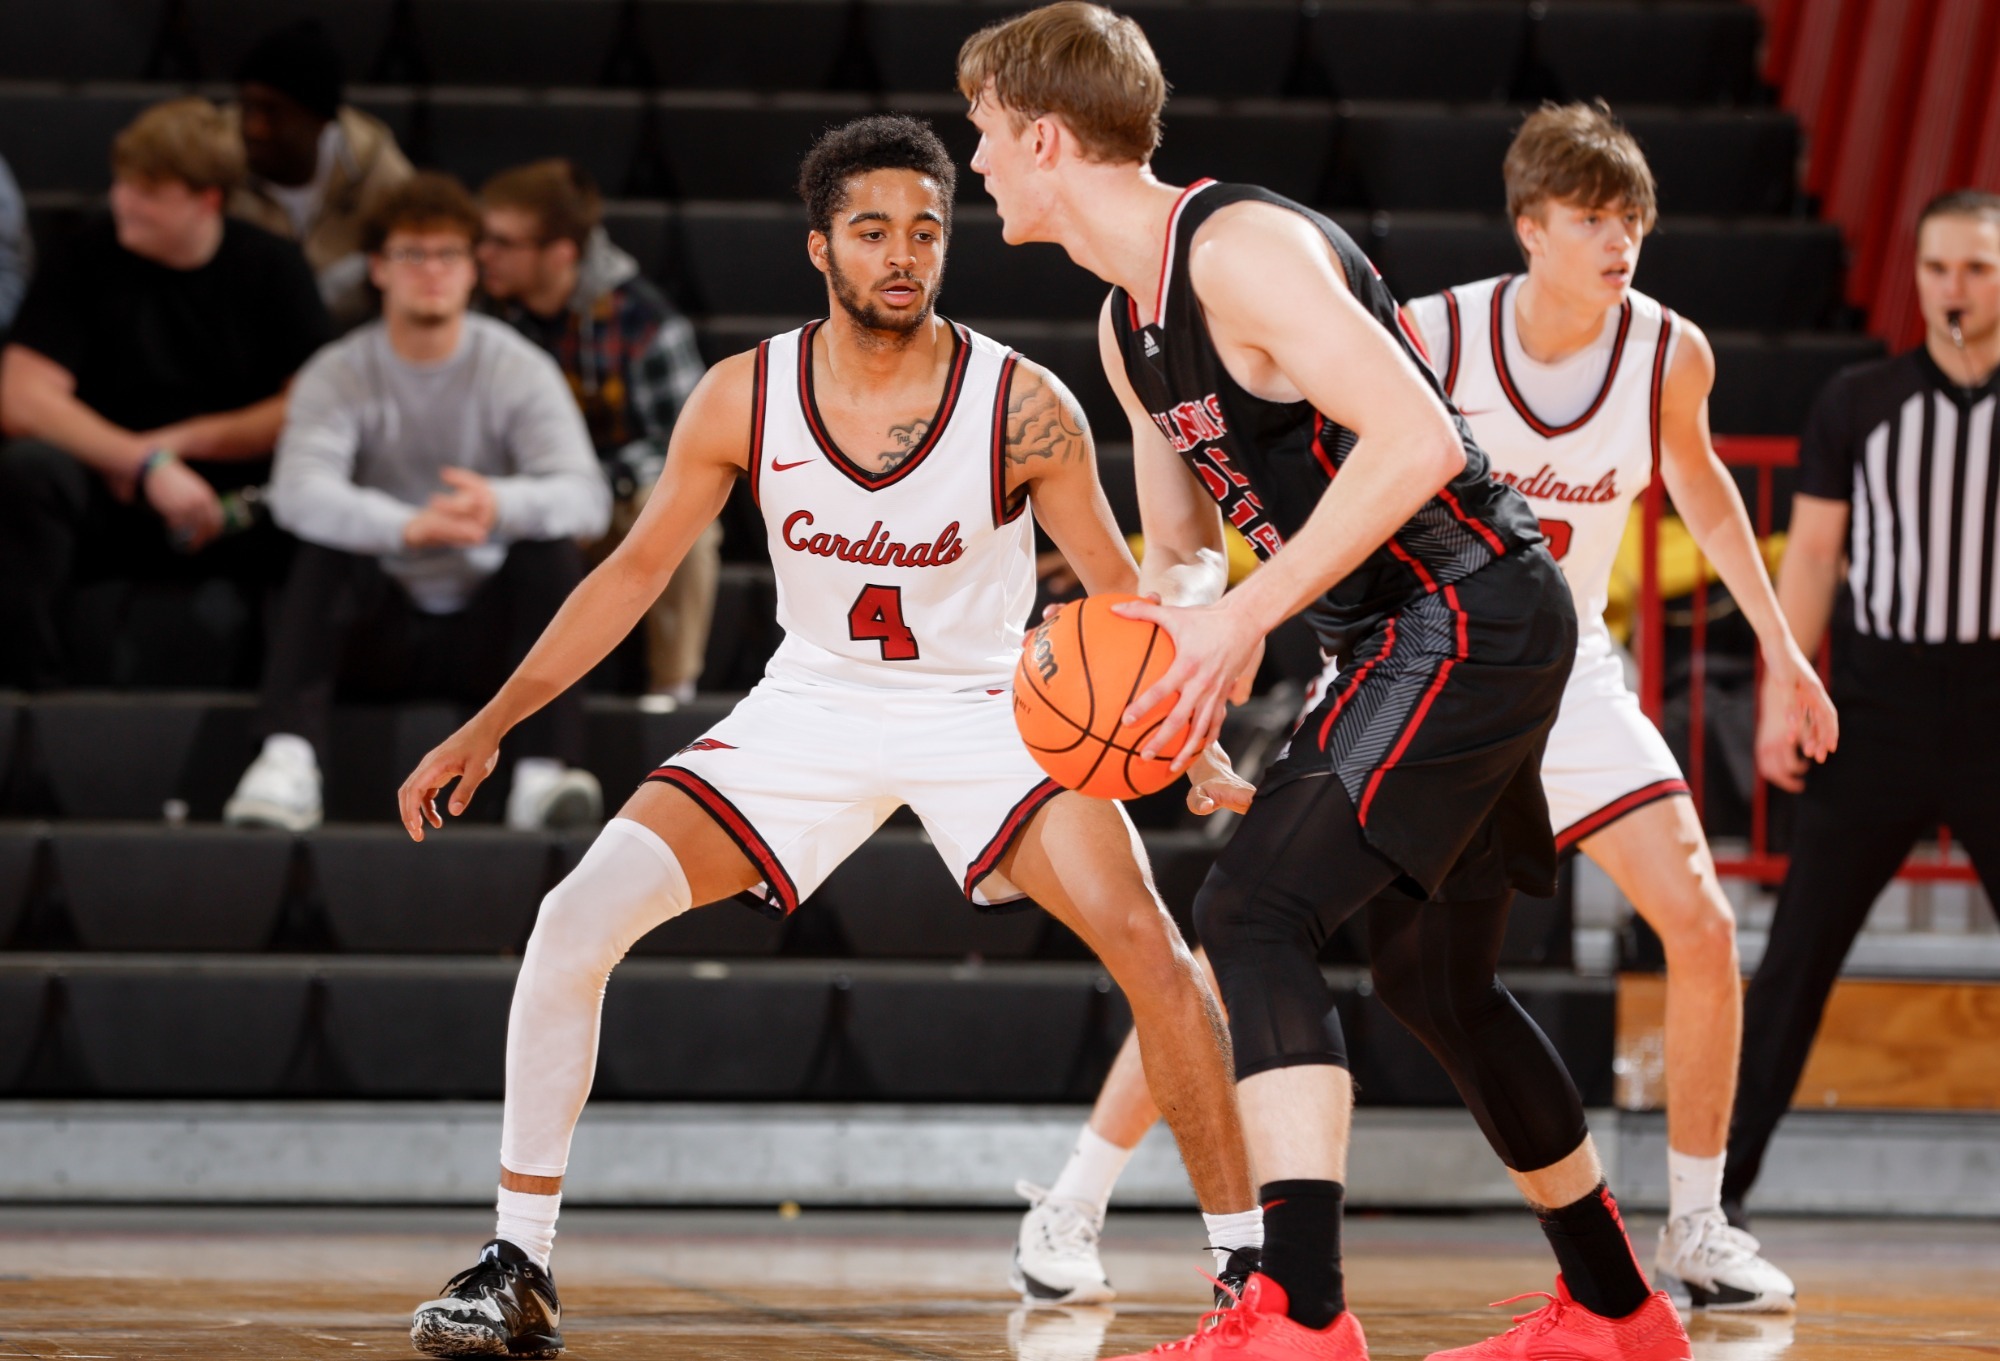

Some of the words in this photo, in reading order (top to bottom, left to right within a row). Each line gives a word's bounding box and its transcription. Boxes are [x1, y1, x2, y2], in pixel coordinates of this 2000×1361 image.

[1488, 464, 1620, 503] ardinals
[782, 510, 968, 568] Cardinals
[847, 583, 920, 661] 4
